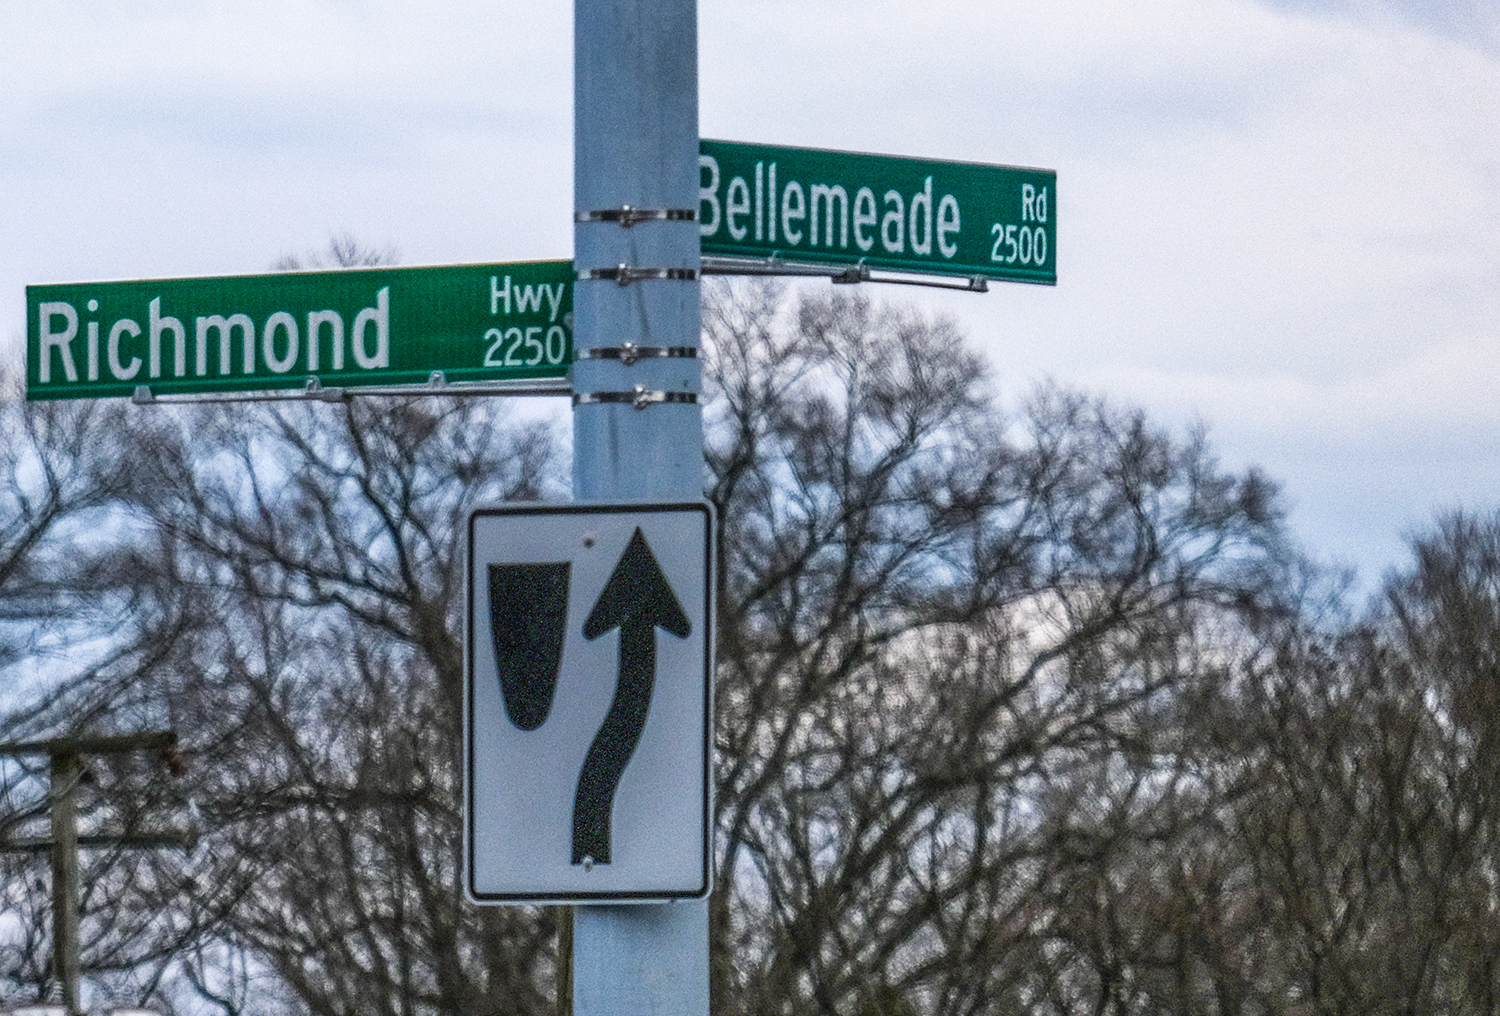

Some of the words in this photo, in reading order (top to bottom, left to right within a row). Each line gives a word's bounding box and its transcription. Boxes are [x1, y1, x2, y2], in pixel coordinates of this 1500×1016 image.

[700, 154, 961, 258] Bellemeade
[1022, 183, 1047, 223] Rd
[990, 223, 1047, 266] 2500
[490, 275, 565, 322] Hwy
[39, 286, 390, 382] Richmond
[484, 325, 566, 367] 2250
